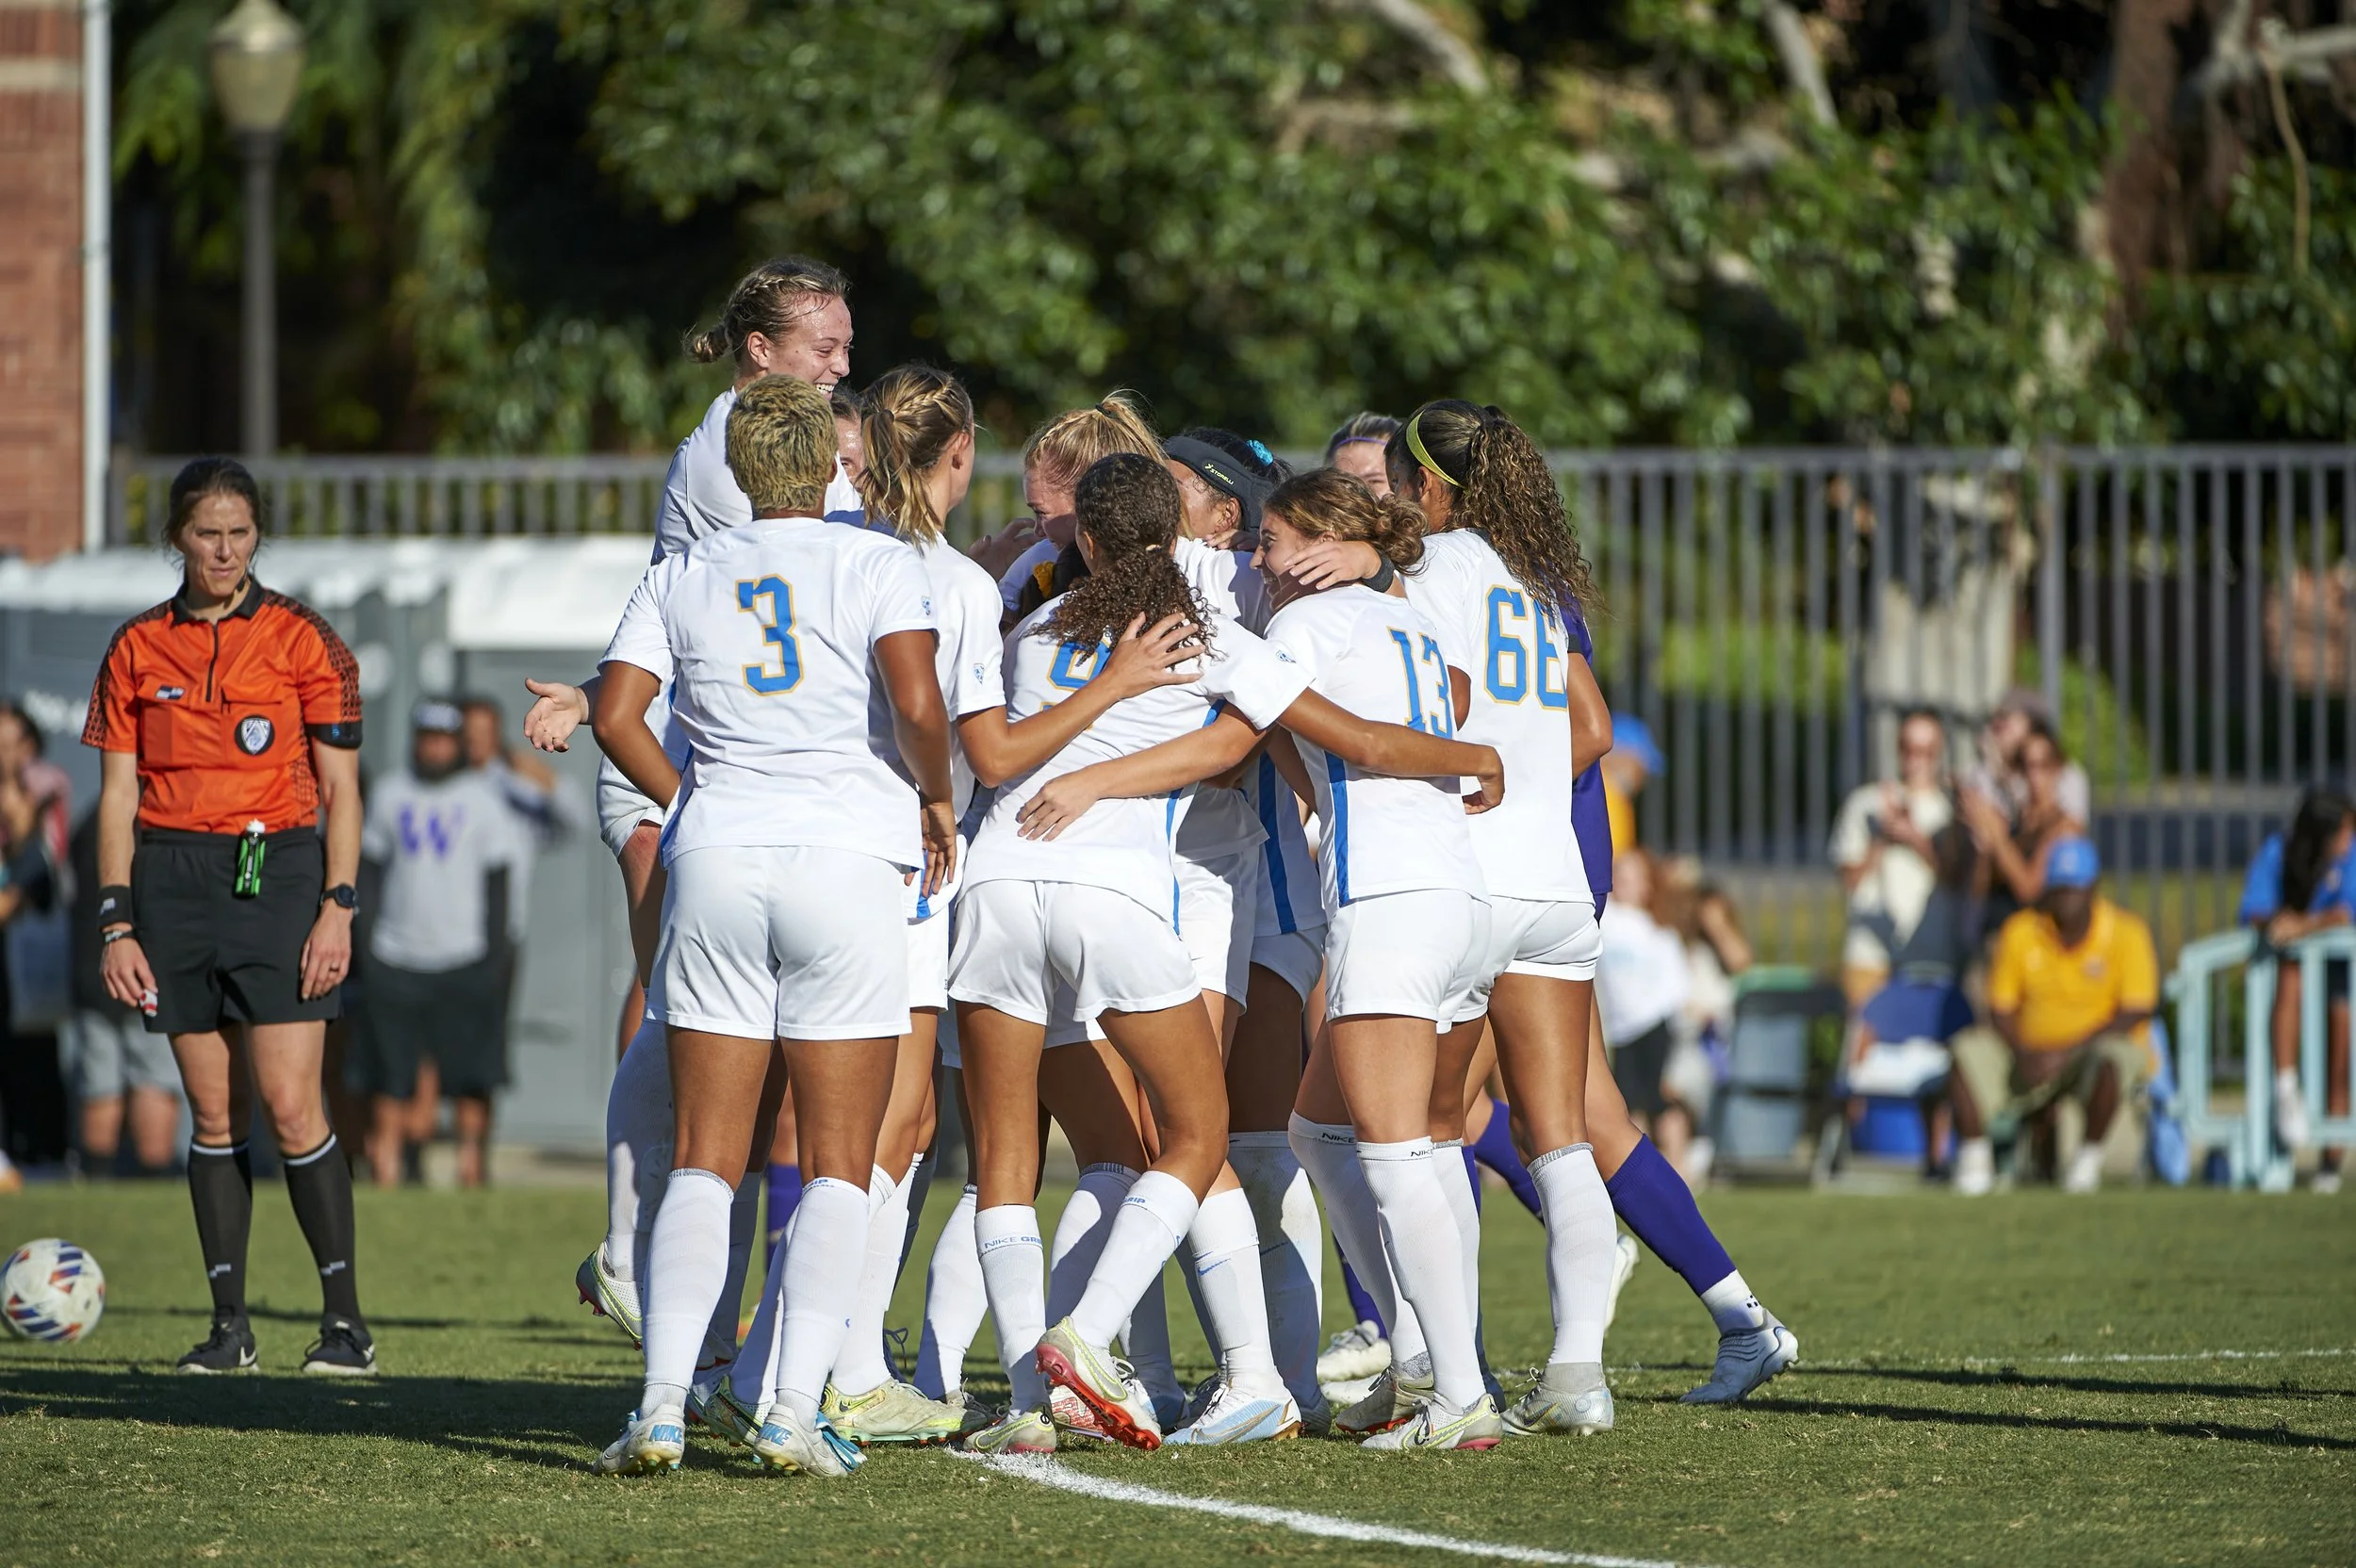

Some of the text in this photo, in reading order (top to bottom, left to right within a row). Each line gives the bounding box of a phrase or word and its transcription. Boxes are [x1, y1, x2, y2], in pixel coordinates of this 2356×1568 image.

[1210, 468, 1235, 485] STORELLI
[735, 574, 804, 695] 3
[1483, 584, 1568, 711] 66
[1387, 626, 1453, 741] 13
[1321, 1132, 1355, 1144] NIKE
[984, 1237, 1017, 1250] NIKE
[648, 1424, 682, 1445] NIKE
[758, 1422, 793, 1446] NIKE
